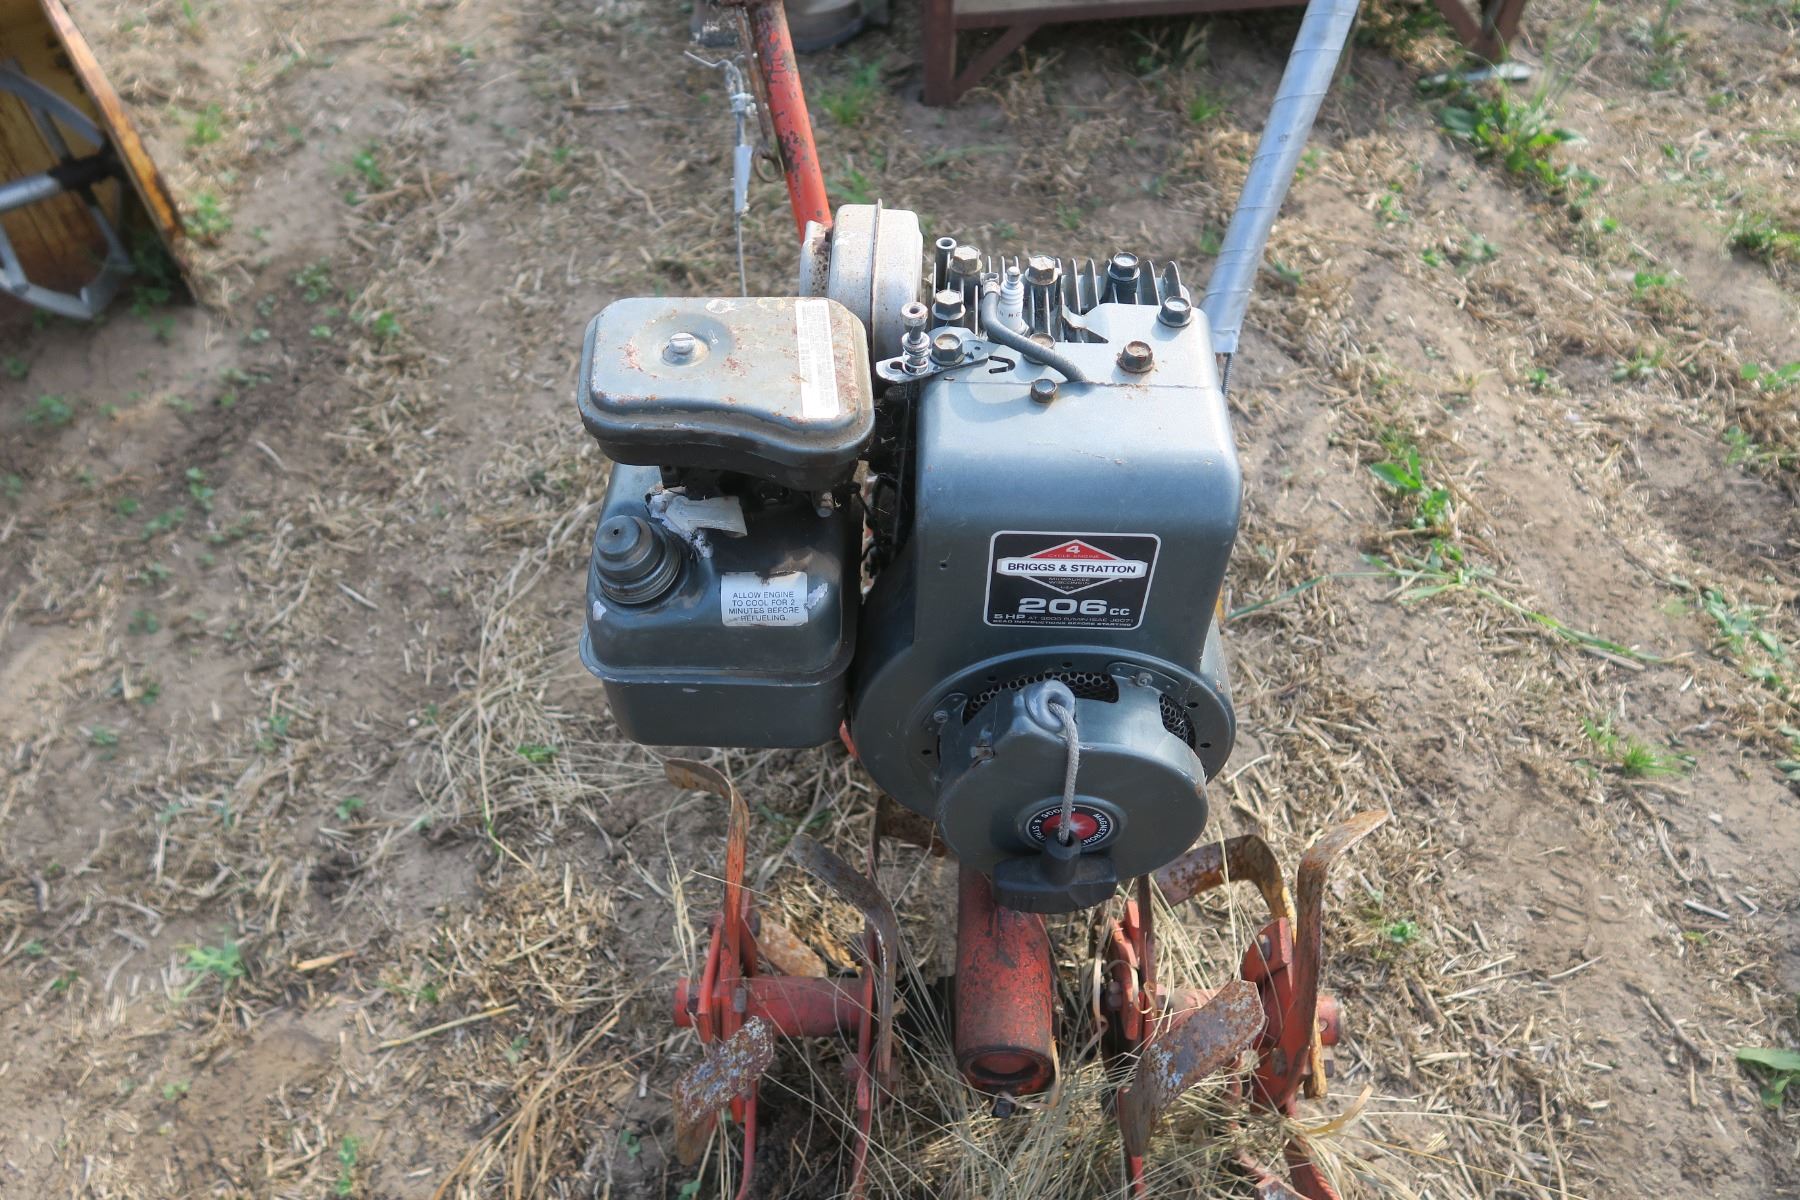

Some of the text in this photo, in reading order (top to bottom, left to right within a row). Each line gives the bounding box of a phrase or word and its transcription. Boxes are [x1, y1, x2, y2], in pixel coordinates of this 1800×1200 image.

[1065, 545, 1081, 555] 4
[1007, 562, 1137, 574] BRIGGS & STRATTON
[767, 606, 799, 614] BEFORE
[1018, 597, 1108, 616] 206
